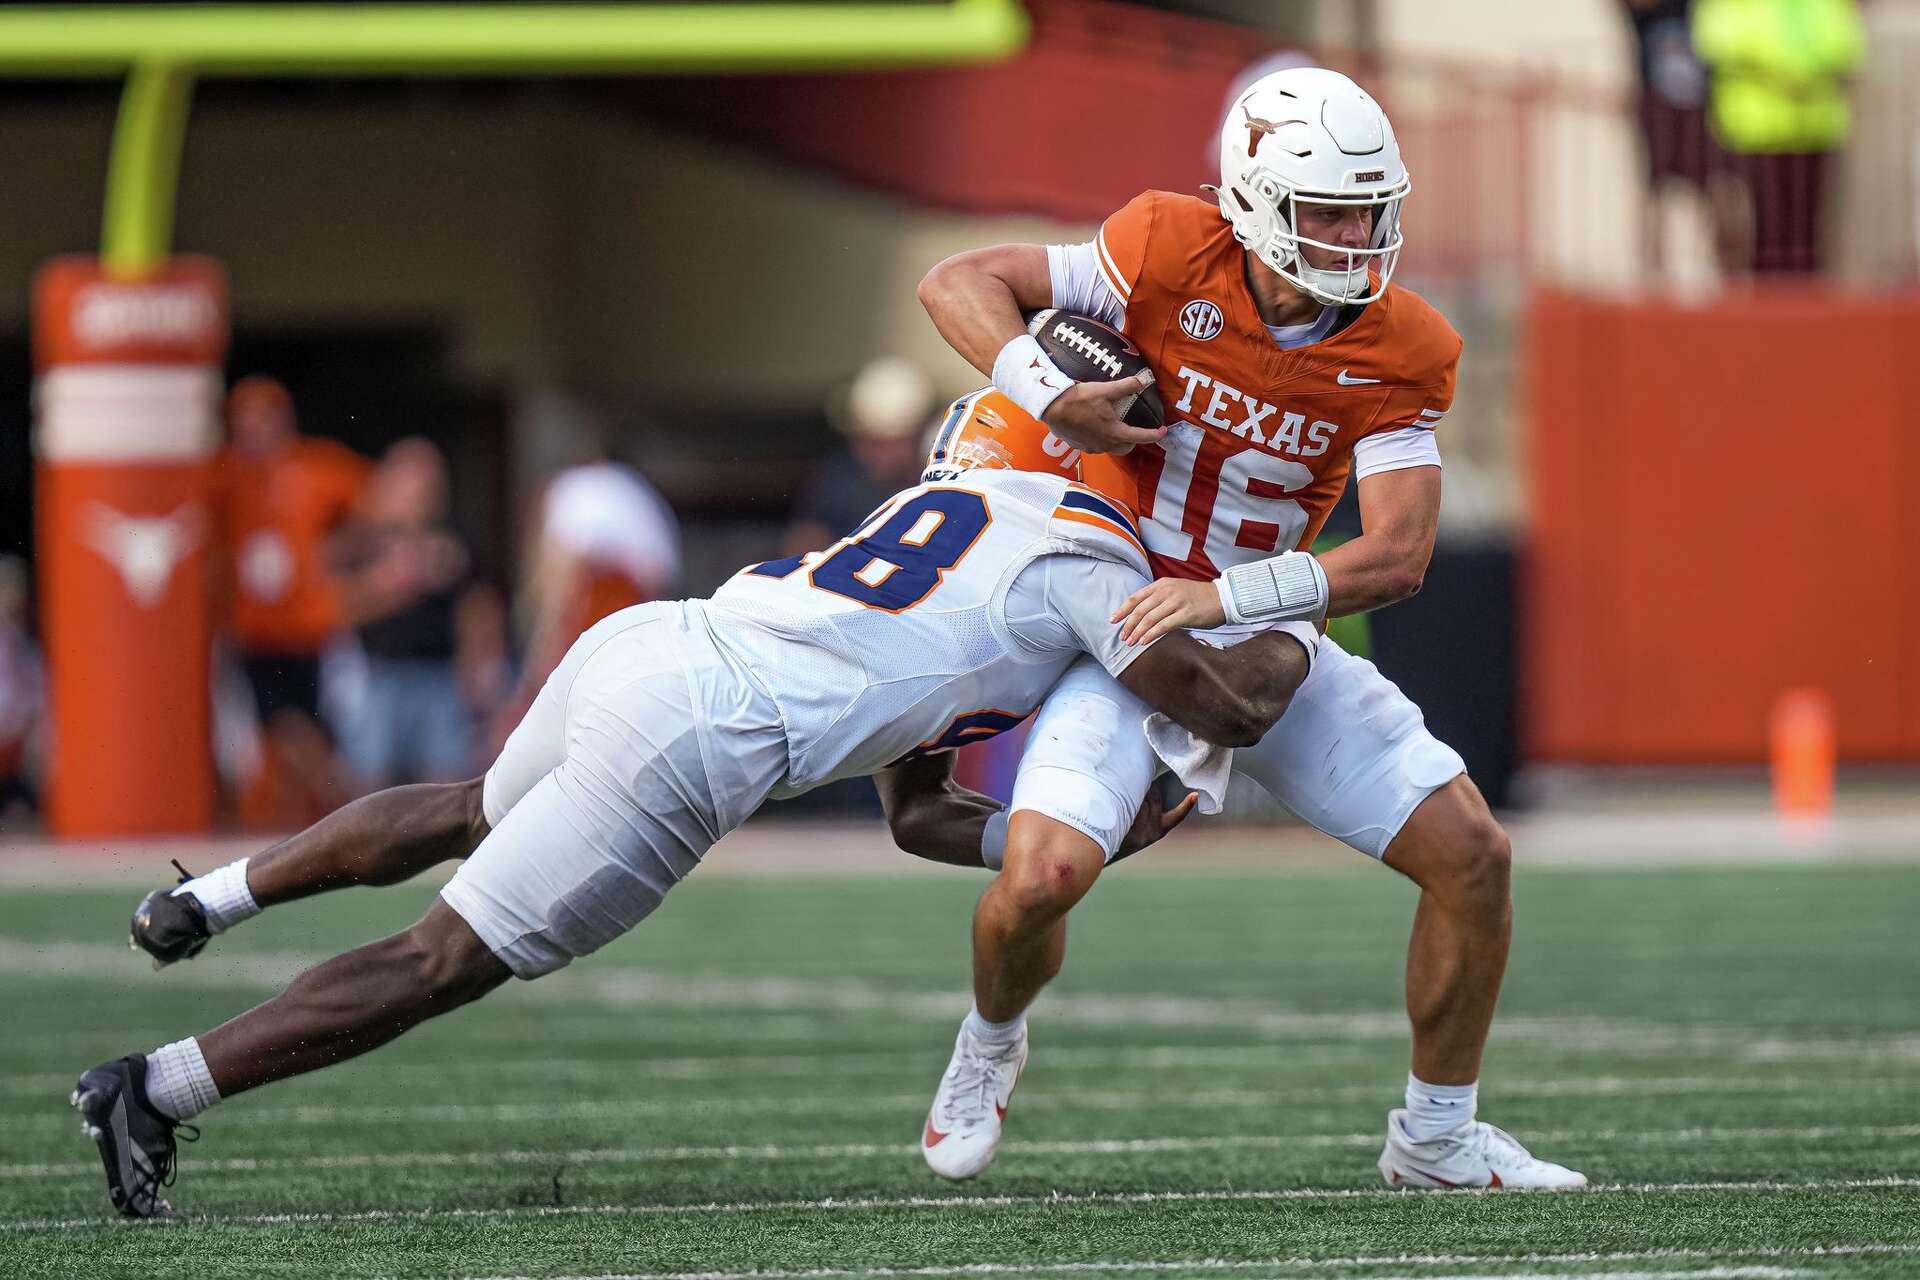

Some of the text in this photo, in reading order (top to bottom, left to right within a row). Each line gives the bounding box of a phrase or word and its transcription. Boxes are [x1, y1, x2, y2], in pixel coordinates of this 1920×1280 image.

[1181, 302, 1221, 339] SEC
[1175, 365, 1339, 457] TEXAS
[1138, 419, 1314, 574] 16
